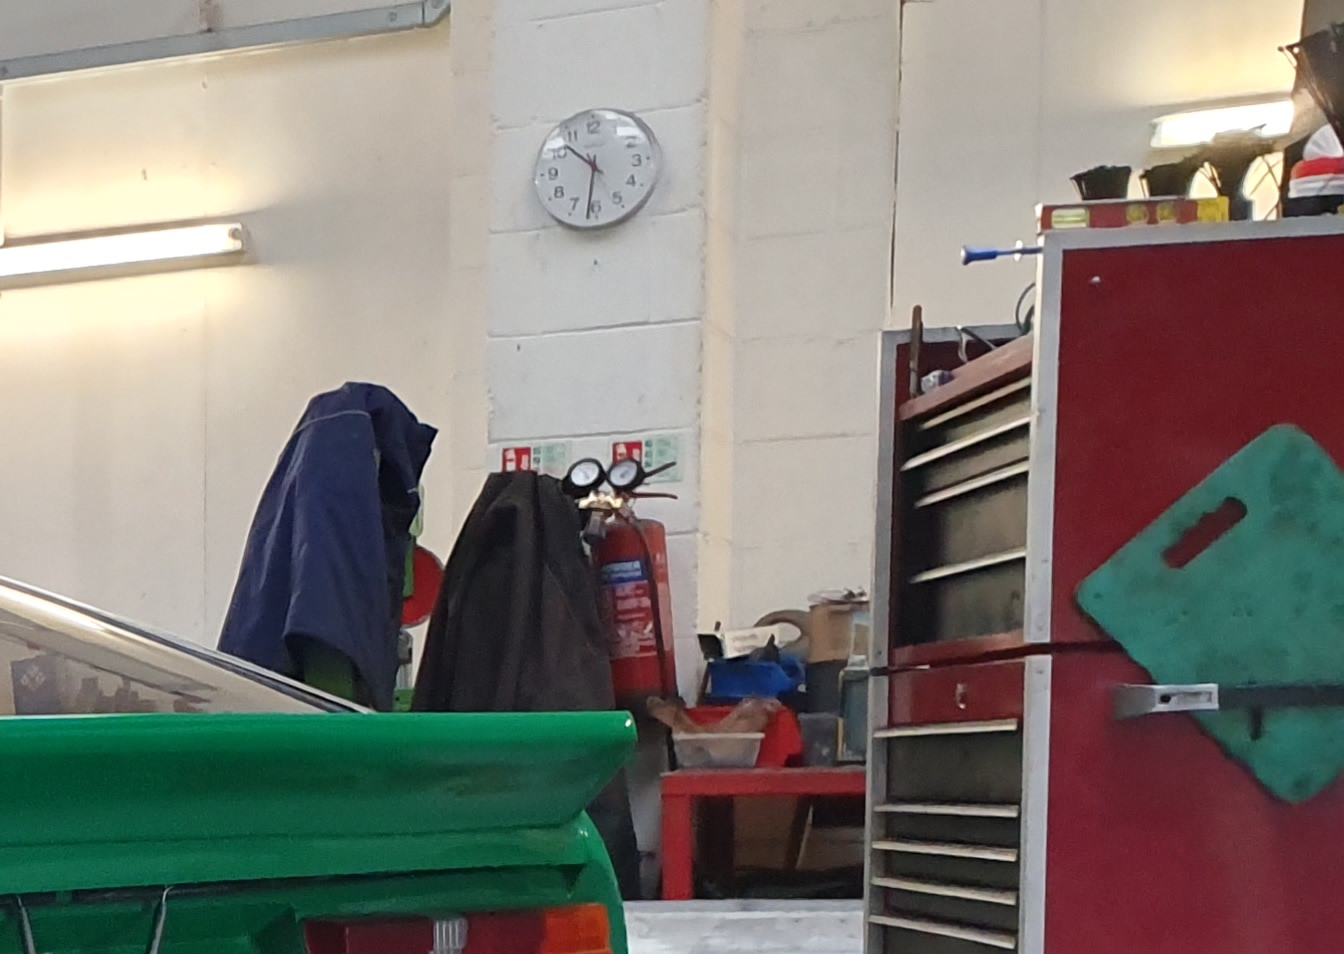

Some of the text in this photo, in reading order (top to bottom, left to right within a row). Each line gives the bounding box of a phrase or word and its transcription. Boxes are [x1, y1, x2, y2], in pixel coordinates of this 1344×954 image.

[586, 120, 601, 134] 12
[567, 129, 578, 143] 11
[631, 153, 642, 167] 3
[547, 166, 559, 181] 9
[625, 173, 637, 187] 4
[553, 185, 565, 199] 8
[611, 190, 623, 205] 5
[569, 196, 580, 211] 7
[590, 200, 602, 214] 6
